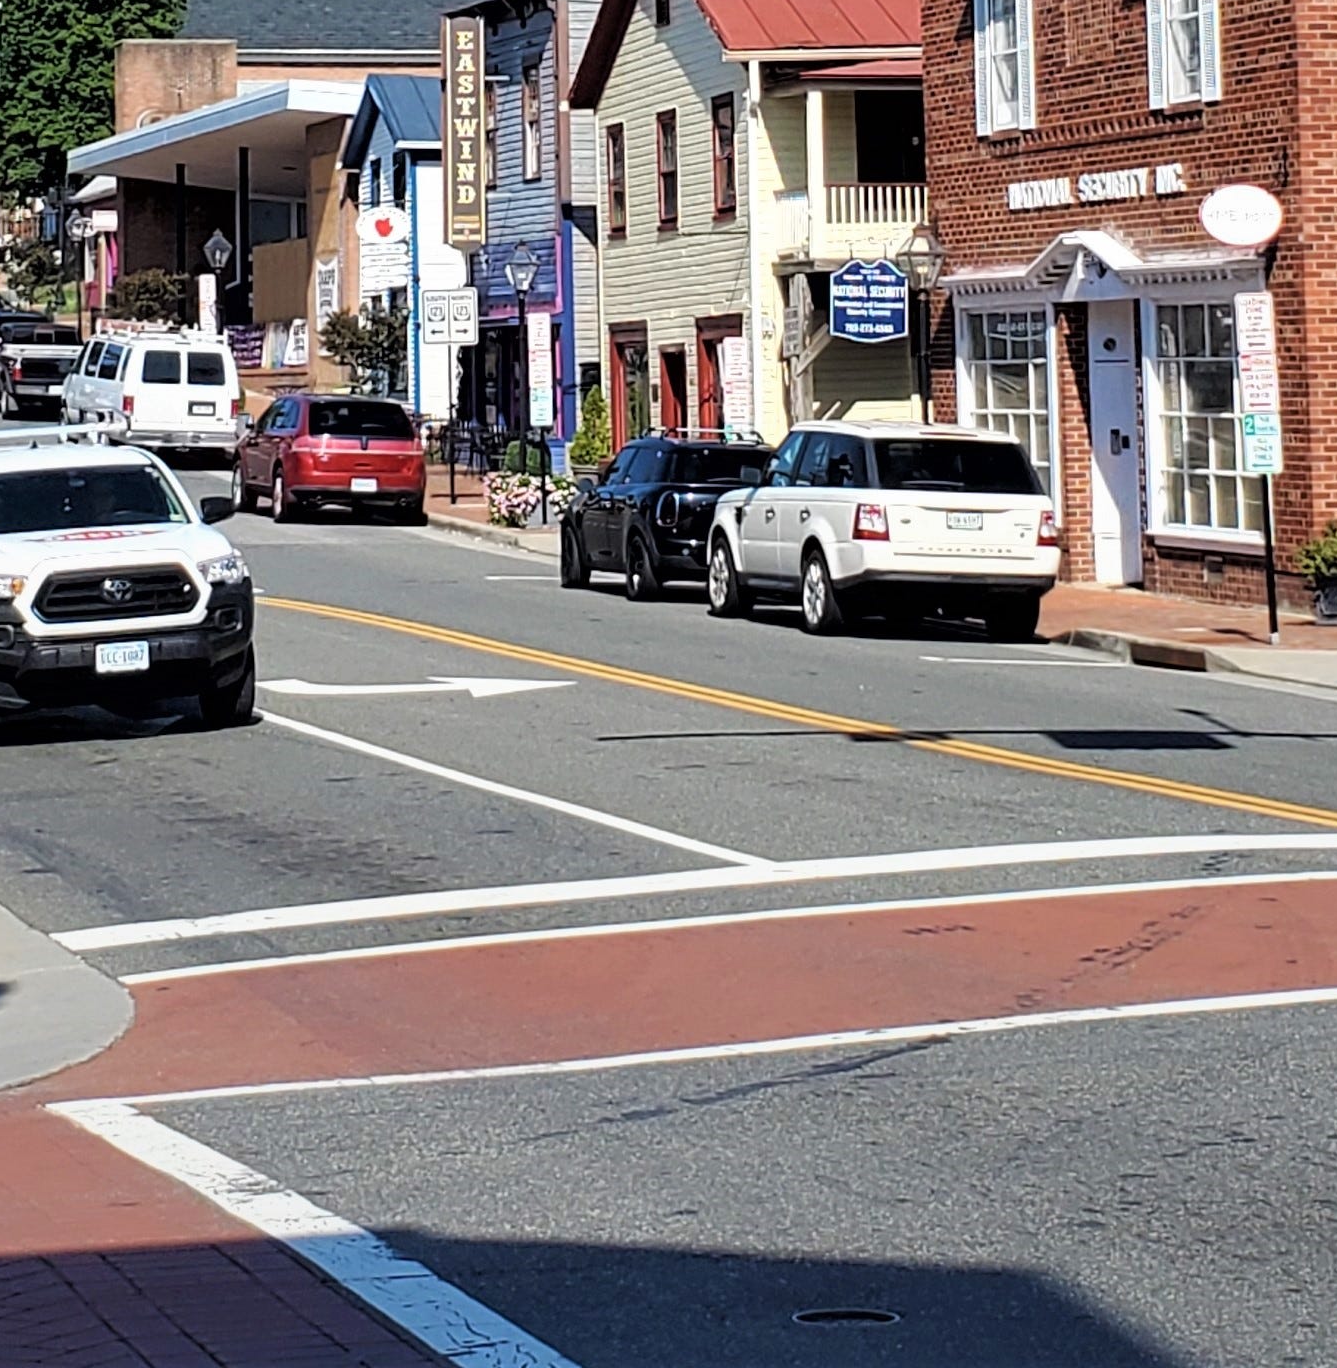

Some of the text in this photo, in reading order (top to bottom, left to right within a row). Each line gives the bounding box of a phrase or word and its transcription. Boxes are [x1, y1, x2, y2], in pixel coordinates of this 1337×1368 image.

[454, 30, 479, 204] EASTWIND
[1078, 167, 1149, 202] SECURITY
[456, 306, 468, 316] 123
